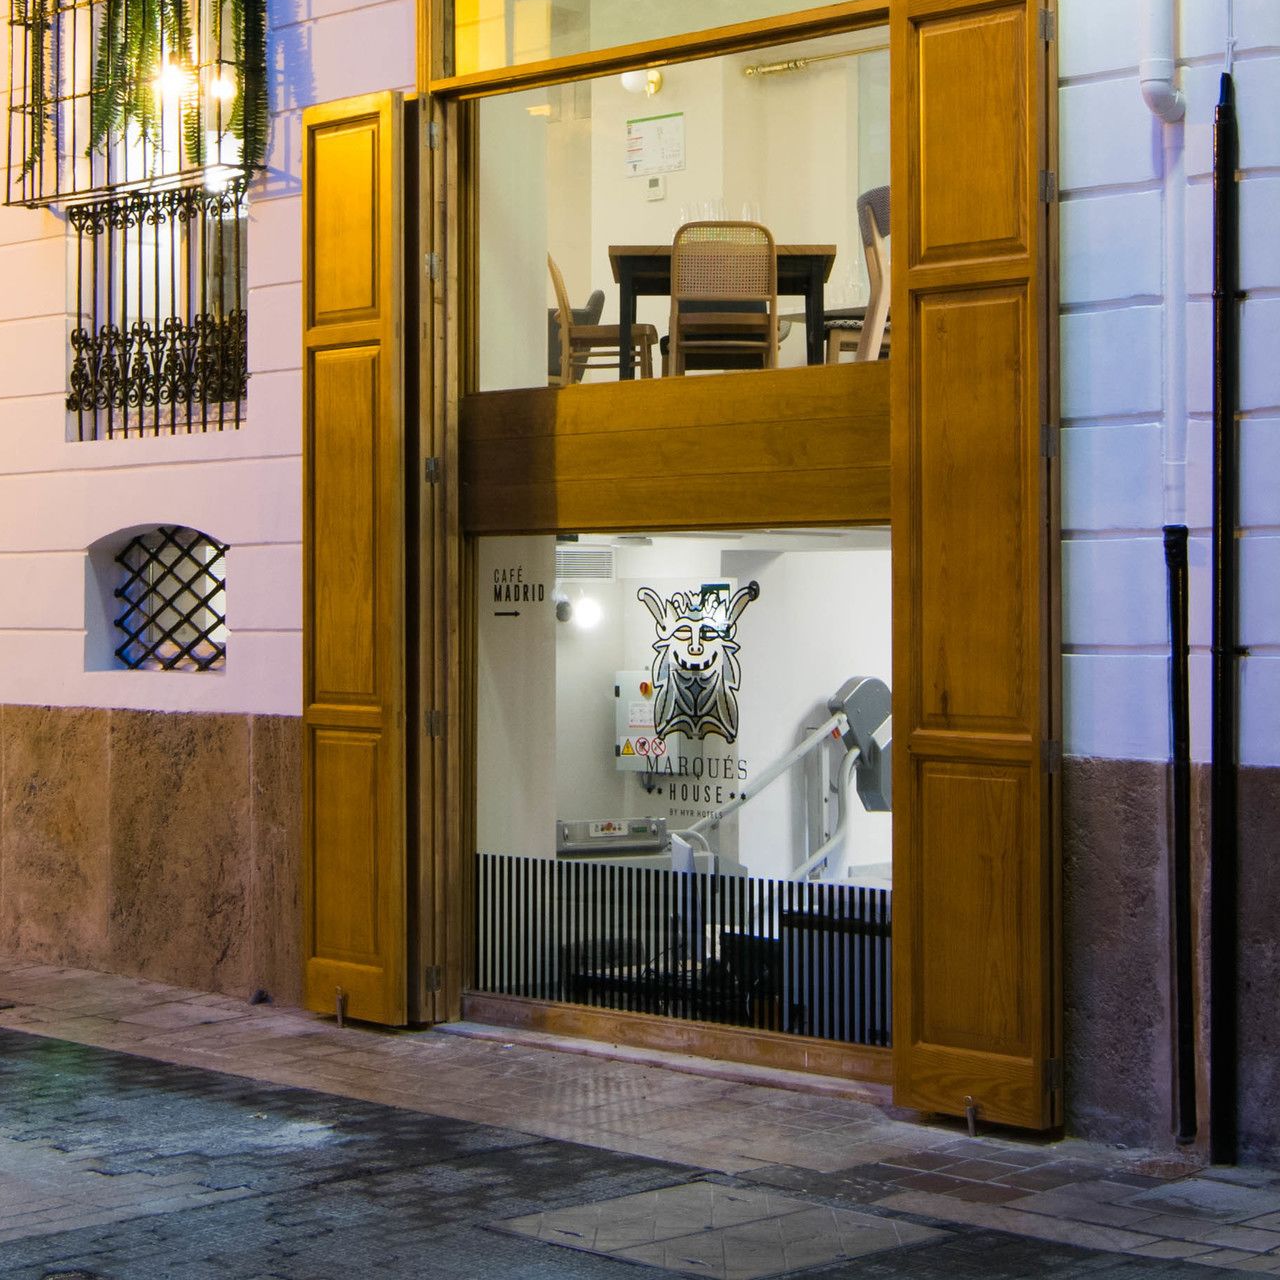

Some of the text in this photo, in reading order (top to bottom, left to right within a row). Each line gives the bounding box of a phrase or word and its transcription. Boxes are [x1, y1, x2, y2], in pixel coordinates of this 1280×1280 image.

[494, 565, 523, 583] CAFÉ
[494, 584, 545, 602] MADRID
[645, 755, 748, 780] MARQUÉS
[670, 783, 723, 804] HOUSE
[669, 808, 678, 816] BY
